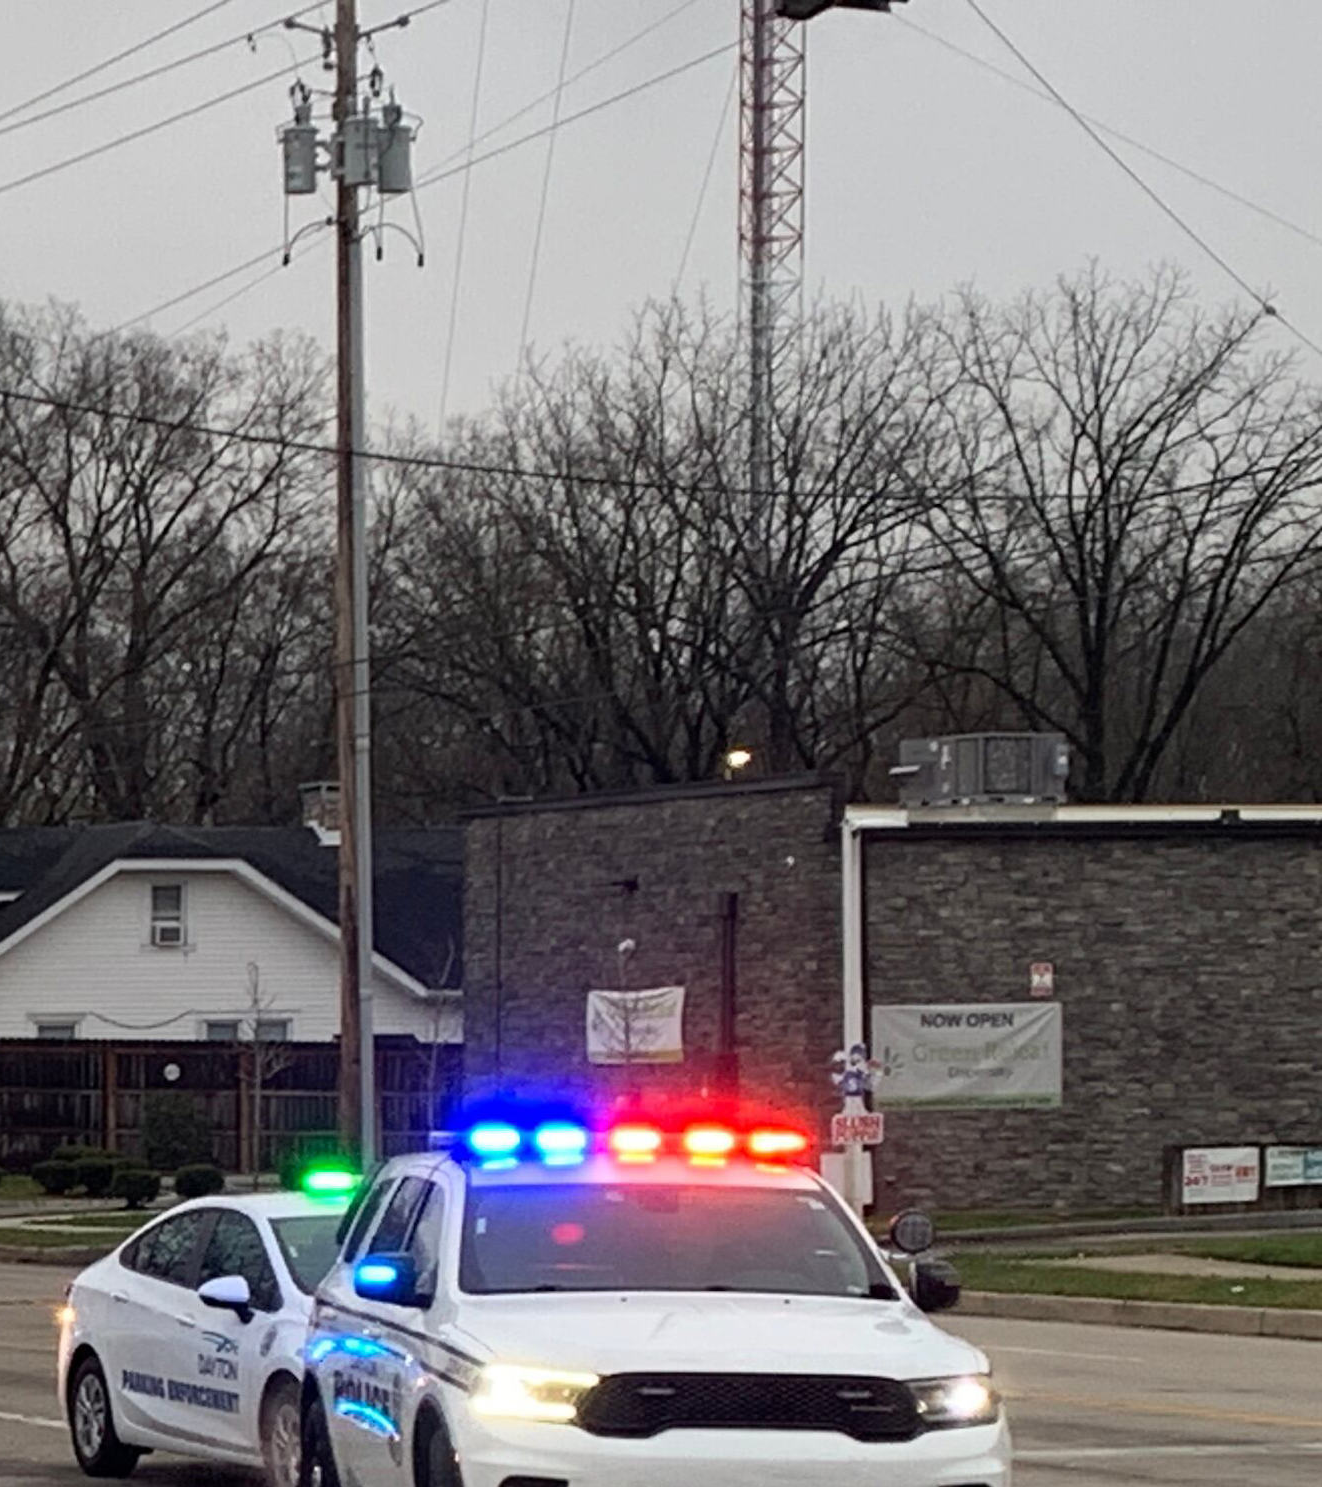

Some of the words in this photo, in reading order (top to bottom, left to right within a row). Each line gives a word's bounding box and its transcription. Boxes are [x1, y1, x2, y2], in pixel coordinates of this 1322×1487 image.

[920, 1012, 962, 1028] NOW
[966, 1012, 1014, 1028] OPEN
[198, 1352, 239, 1380] DAYTON
[122, 1369, 165, 1398] PARKING
[168, 1378, 240, 1413] ENFORCEMENT
[334, 1370, 391, 1415] POLICE
